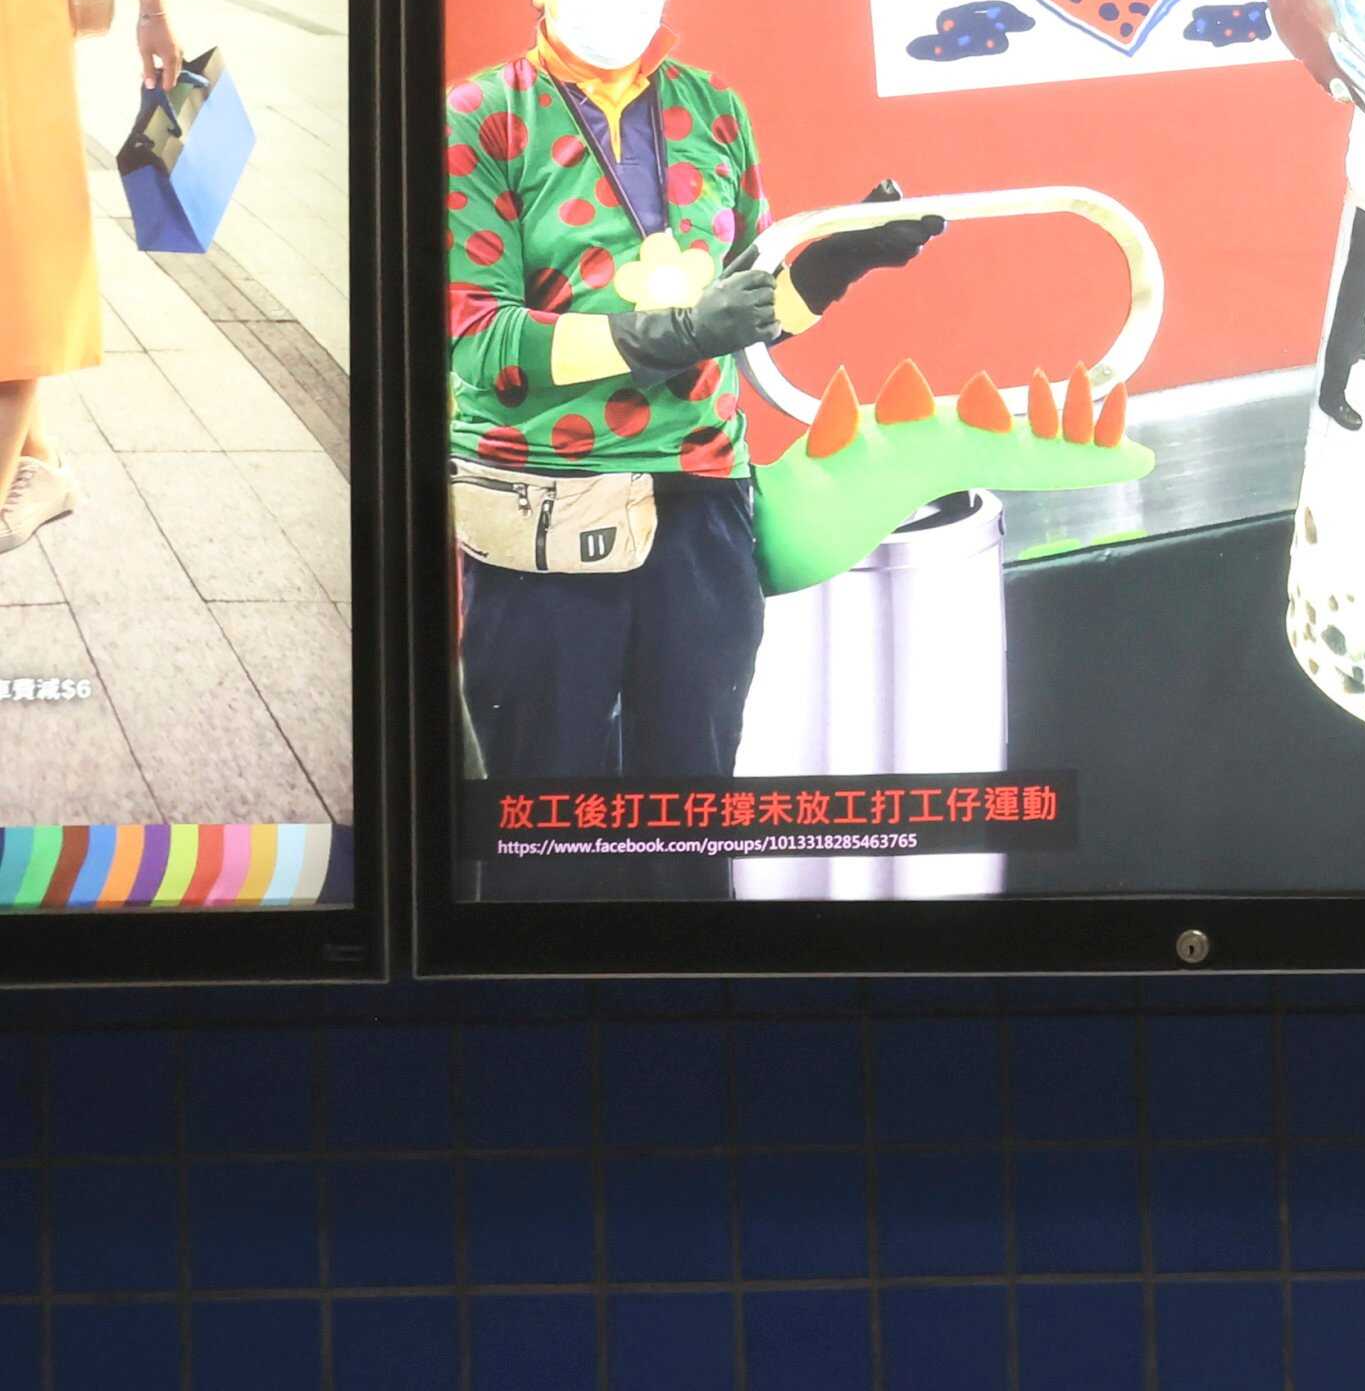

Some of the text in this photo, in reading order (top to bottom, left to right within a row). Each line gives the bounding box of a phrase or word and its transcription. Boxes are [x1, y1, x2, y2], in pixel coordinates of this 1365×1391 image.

[499, 785, 1057, 830] 放工後打工仔撐未放工打工仔運動
[497, 832, 918, 857] https://www.facebook.com/groups/1013318285463765
